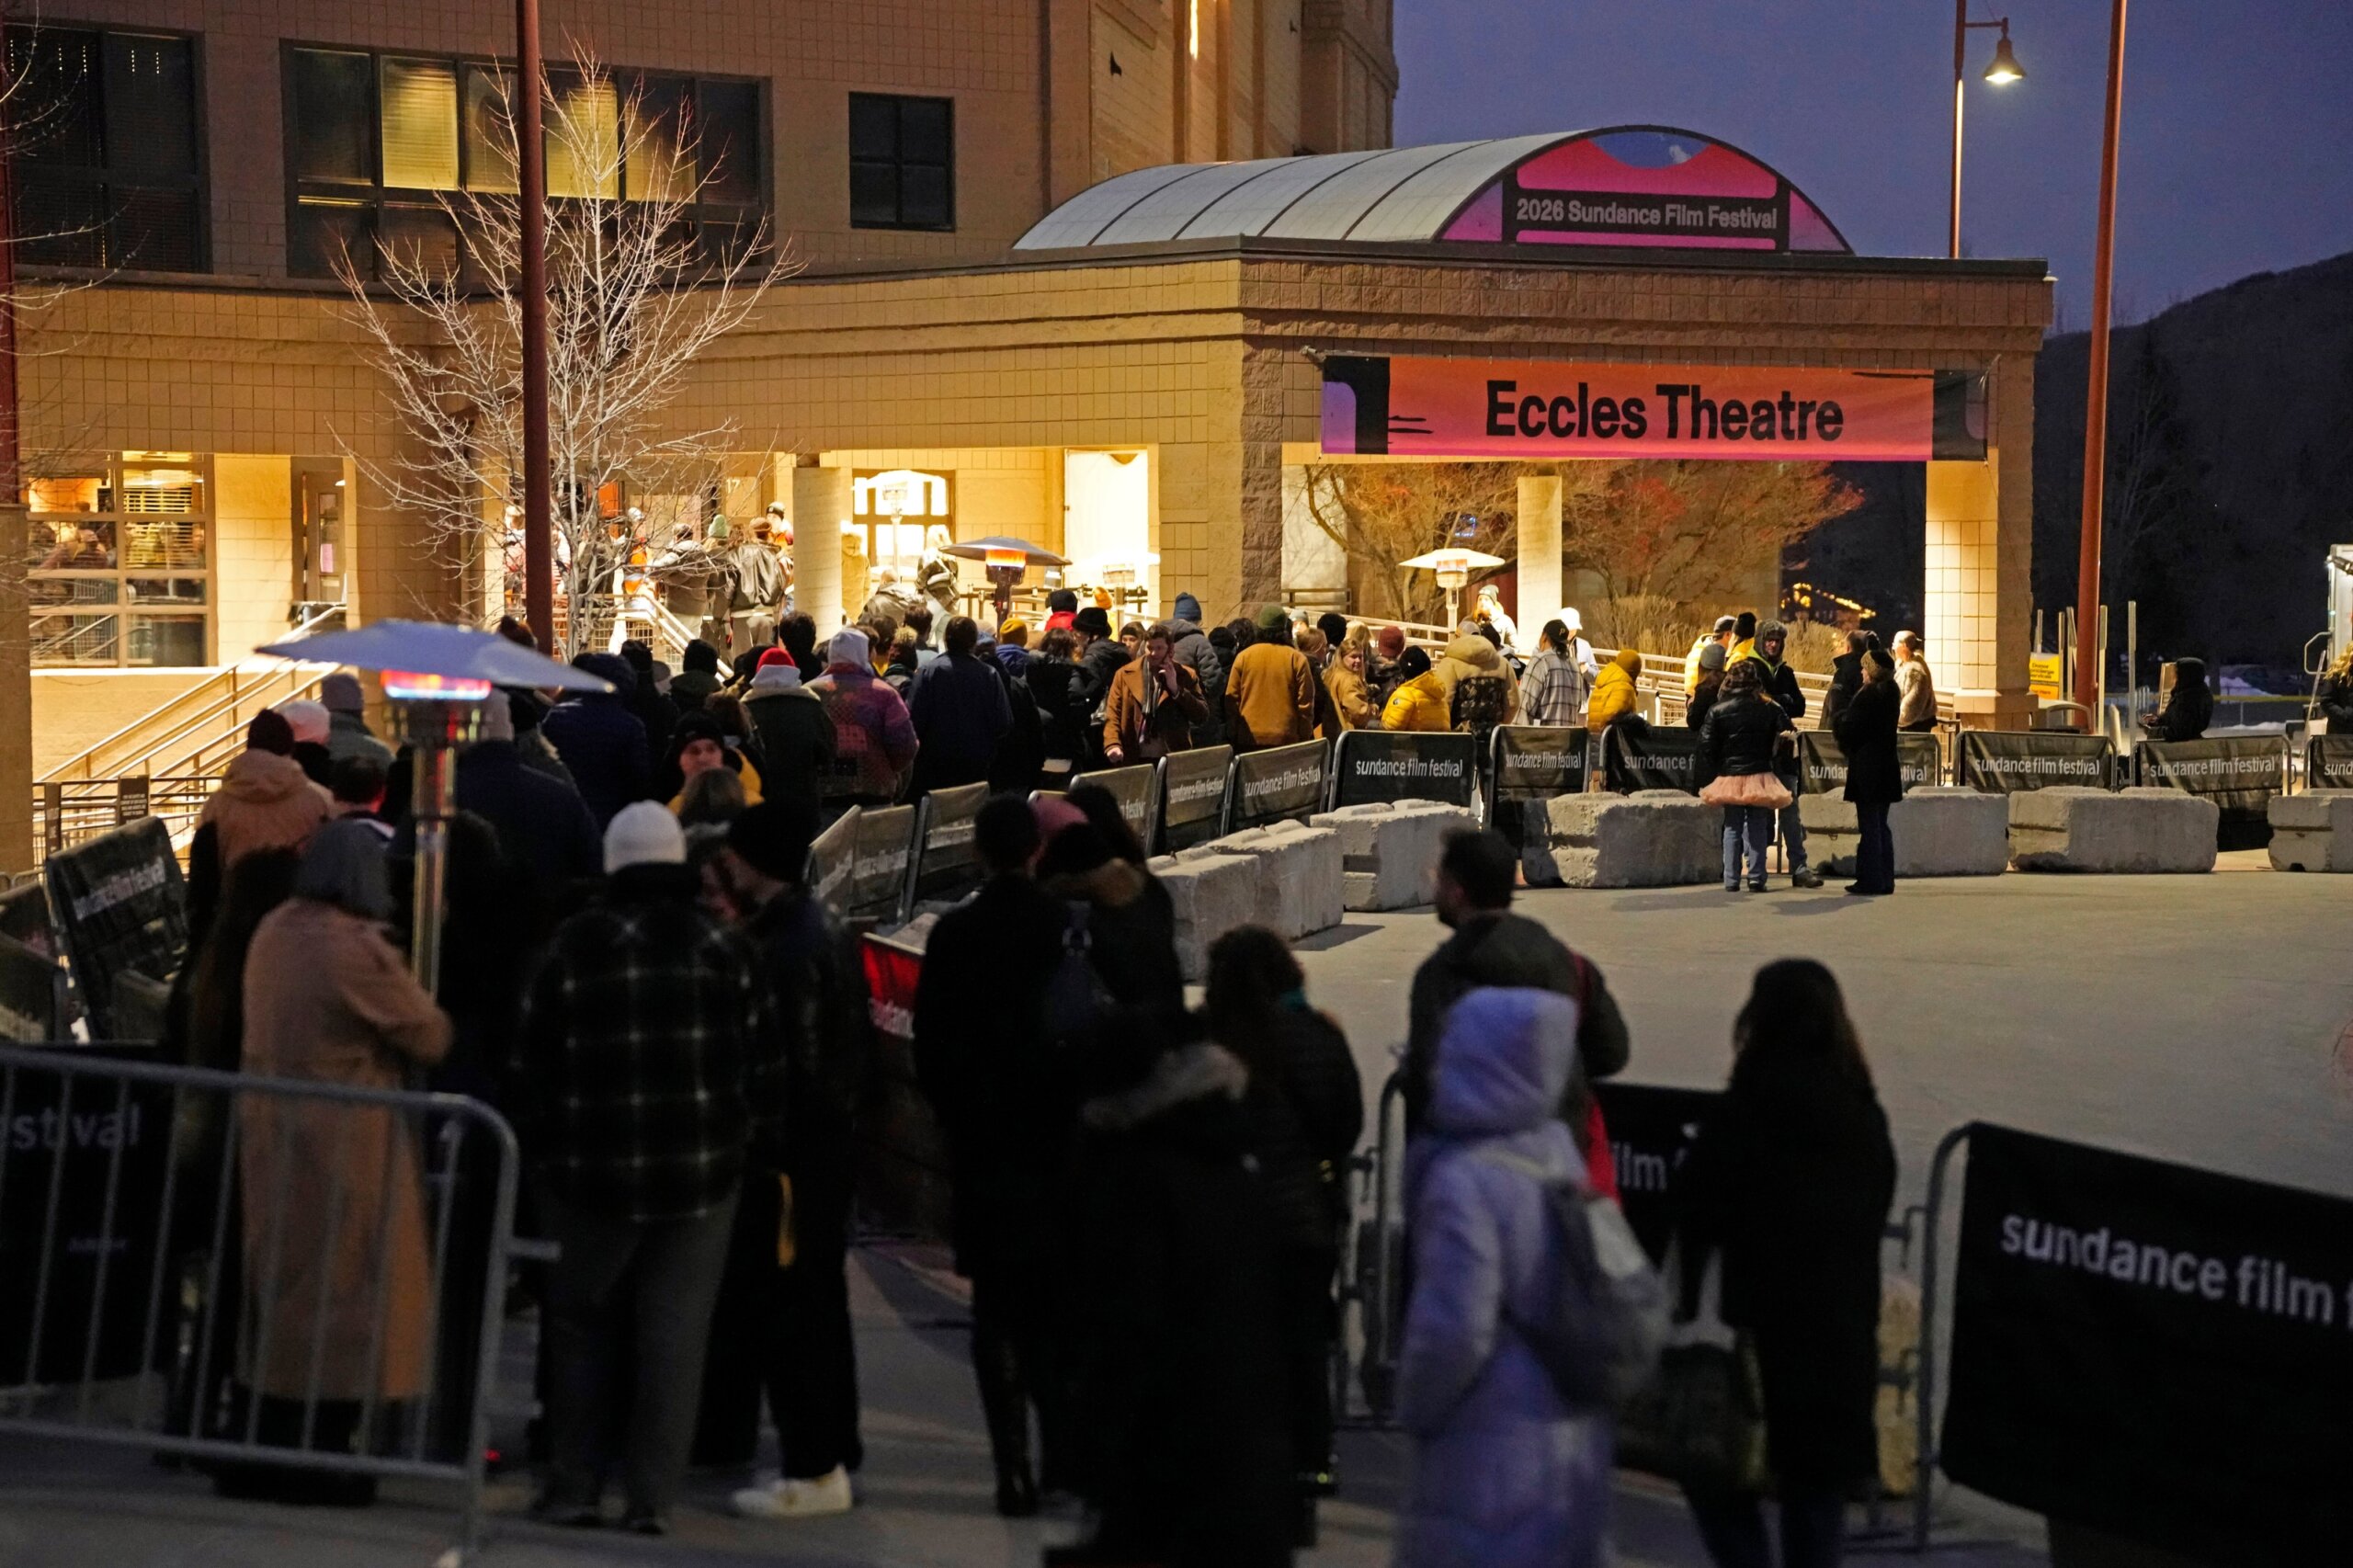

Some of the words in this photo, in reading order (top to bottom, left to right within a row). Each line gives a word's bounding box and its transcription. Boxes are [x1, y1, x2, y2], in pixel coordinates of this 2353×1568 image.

[1517, 198, 1564, 222] 2026
[1568, 203, 1661, 225] Sundance
[1665, 203, 1703, 226] Film
[1708, 205, 1778, 229] Festival
[1485, 381, 1648, 438] Eccles
[1655, 383, 1844, 441] Theatre
[1356, 759, 1406, 776] sundance
[1407, 758, 1427, 777] film
[1428, 758, 1463, 778] festival
[1506, 752, 1540, 768] sundance
[1541, 752, 1557, 768] film
[1624, 754, 1687, 770] sundance
[1974, 758, 2031, 774] sundance
[2032, 758, 2057, 775] film
[2058, 758, 2100, 777] festival
[2150, 760, 2209, 778] sundance
[2210, 758, 2234, 776] film
[2234, 755, 2275, 773] festival
[2324, 761, 2353, 778] sund
[2001, 1213, 2228, 1300] sundance
[2237, 1255, 2335, 1324] film
